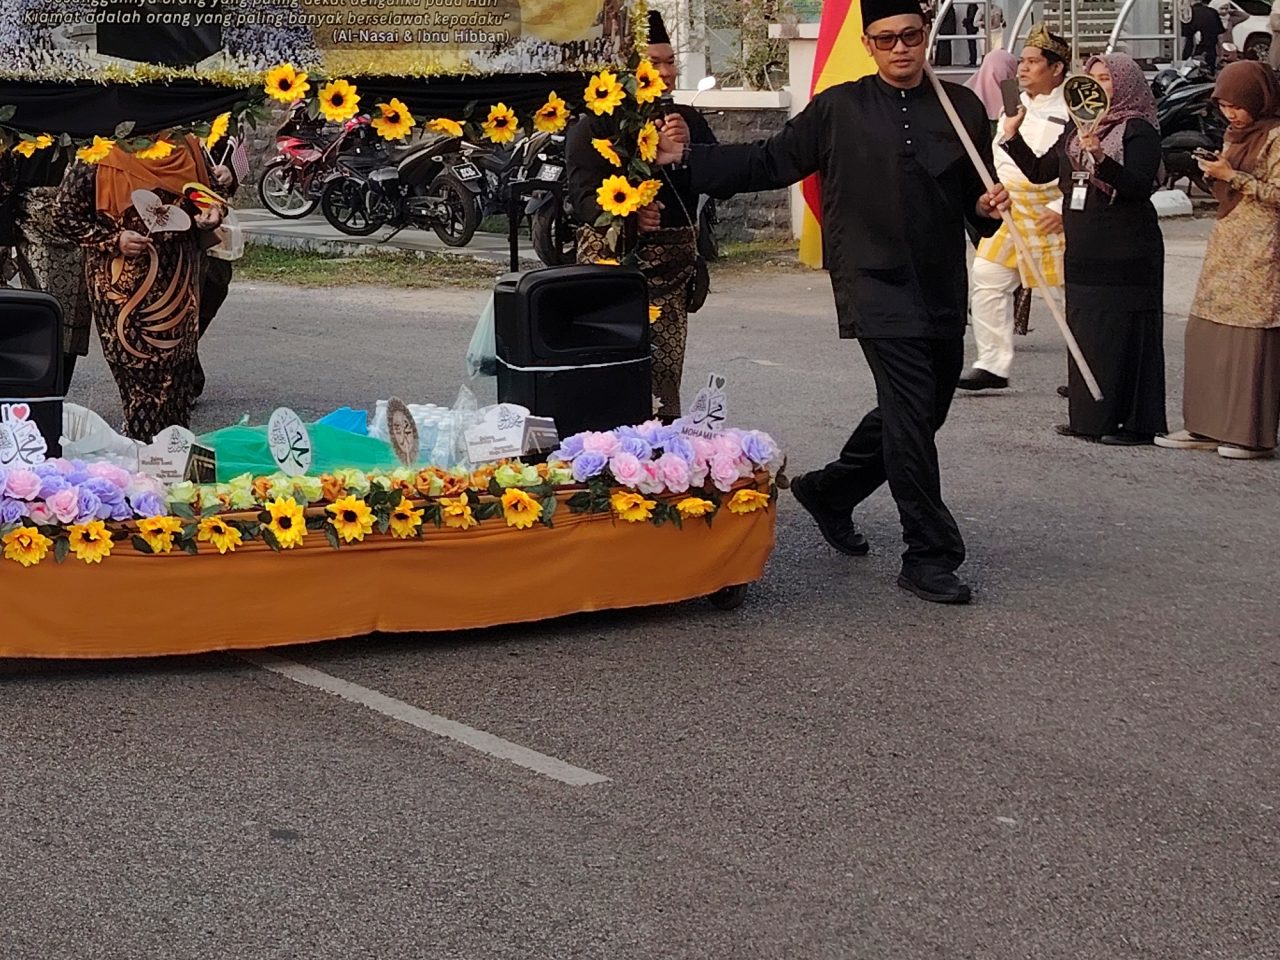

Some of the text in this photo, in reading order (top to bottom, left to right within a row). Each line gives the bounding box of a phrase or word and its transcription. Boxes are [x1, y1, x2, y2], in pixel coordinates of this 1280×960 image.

[23, 10, 511, 27] Kiamat adalah orang yang paling banyak berselawat kepadaku”
[332, 29, 511, 44] (Al-Nasai & Ibnu Hibban)
